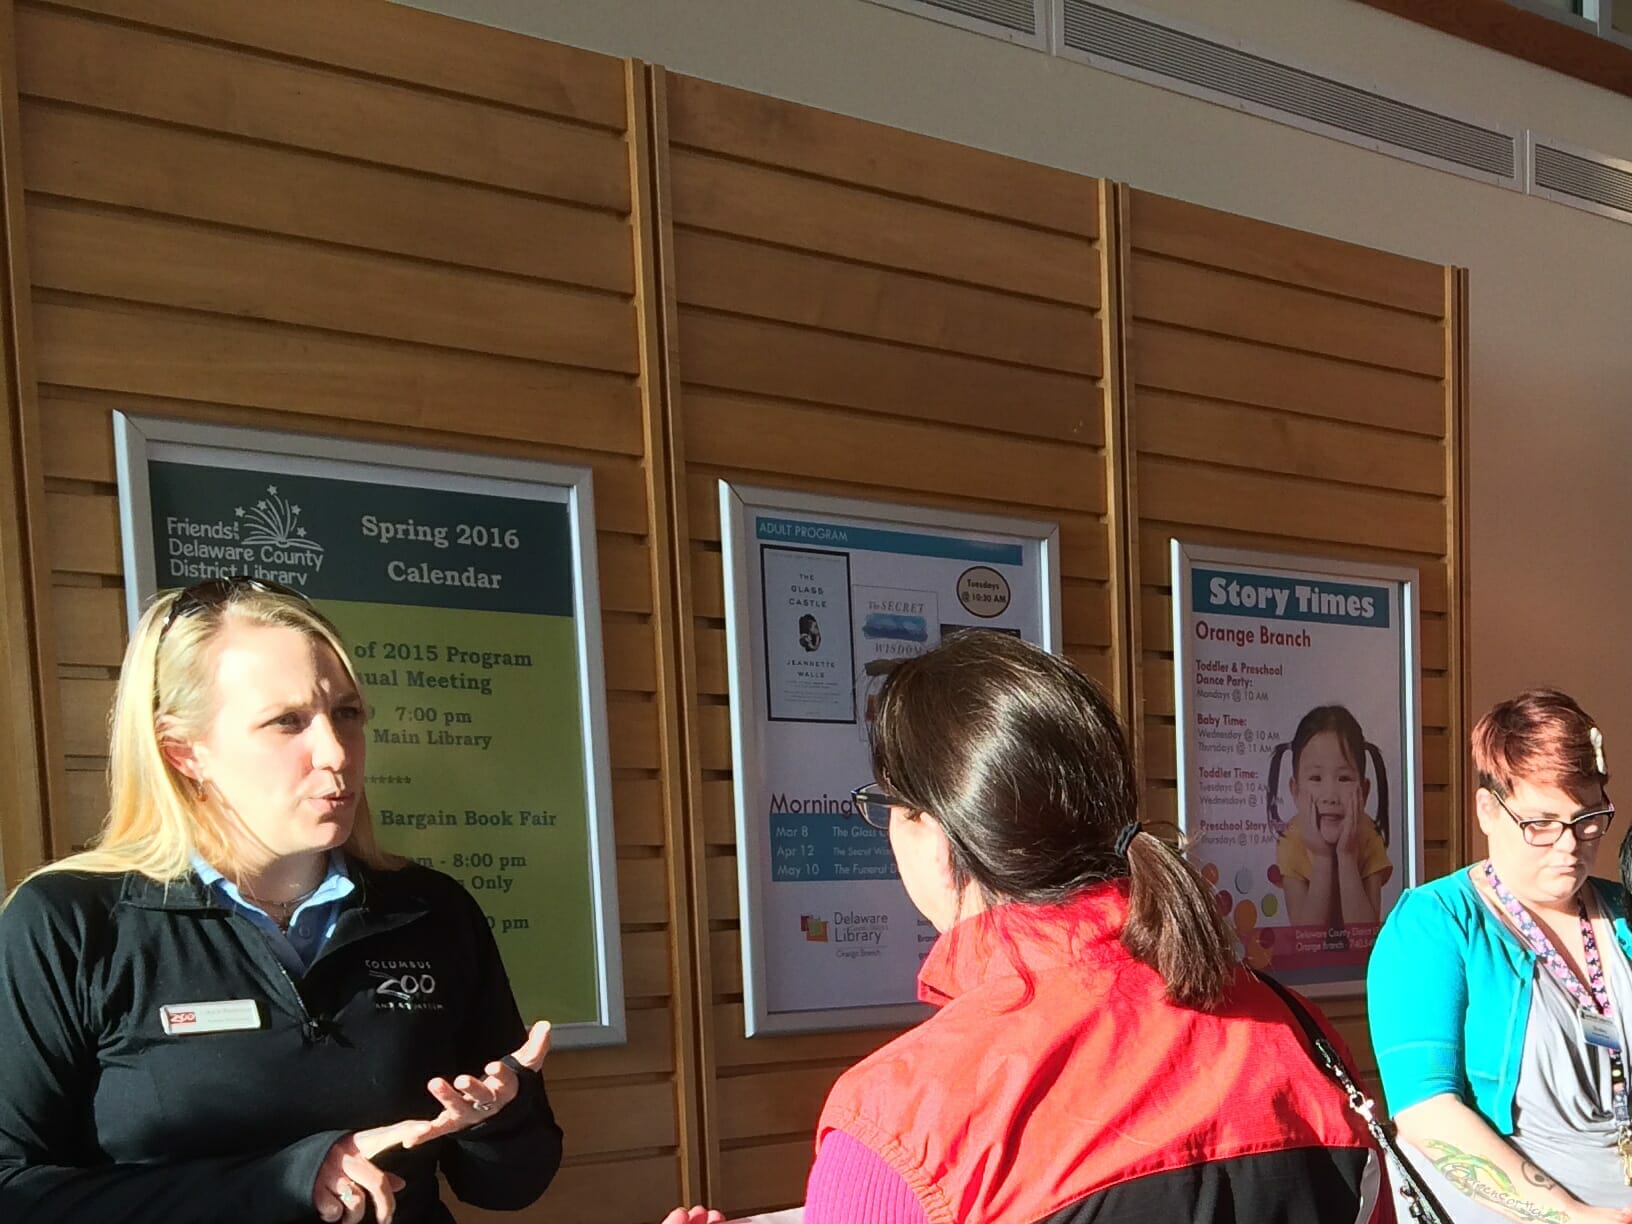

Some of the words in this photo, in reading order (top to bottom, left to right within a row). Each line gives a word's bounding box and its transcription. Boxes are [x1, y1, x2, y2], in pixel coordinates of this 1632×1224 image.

[167, 516, 232, 539] Friends
[361, 515, 449, 548] Spring
[456, 524, 520, 549] 2016
[759, 522, 792, 537] ADULT
[795, 526, 849, 542] PROGRAM
[168, 537, 255, 561] Delaware
[260, 545, 325, 572] County
[170, 558, 238, 580] District
[243, 564, 308, 586] Library
[387, 560, 503, 589] Calendar
[791, 585, 825, 595] GLASS
[966, 579, 1000, 591] Tuesdays
[788, 598, 828, 608] CASTLE
[1209, 576, 1291, 616] Story
[1295, 585, 1376, 619] Times
[880, 600, 925, 614] SECRET
[1195, 620, 1255, 647] Orange
[1260, 625, 1312, 648] Branch
[354, 641, 377, 659] of
[383, 643, 439, 662] 2015
[446, 646, 533, 669] Program
[1195, 659, 1229, 674] Toddler
[1231, 663, 1238, 673] &
[1240, 662, 1283, 677] Preschool
[406, 670, 493, 695] Meeting
[1196, 673, 1224, 686] Dance
[1227, 676, 1253, 688] Party:
[1197, 689, 1230, 701] Mondays
[1231, 689, 1241, 703] @
[1244, 690, 1254, 701] 10
[1255, 691, 1269, 701] AM
[395, 707, 438, 723] 7:00
[444, 711, 472, 726] pm
[1197, 713, 1220, 727] Baby
[1222, 714, 1247, 726] Time:
[373, 729, 420, 745] Main
[427, 730, 493, 750] Library
[1243, 728, 1254, 742] @
[1255, 730, 1266, 740] 10
[1267, 731, 1280, 740] AM
[1236, 741, 1246, 755] @
[1259, 744, 1272, 753] AM
[1198, 766, 1232, 778] Toddler
[1233, 767, 1259, 779] Time:
[1245, 782, 1256, 792] 10
[380, 810, 457, 830] Bargain
[464, 810, 513, 826] Book
[519, 810, 557, 826] Fair
[1200, 819, 1243, 831] Preschool
[1245, 819, 1267, 833] Story
[775, 826, 798, 838] Mar
[801, 825, 809, 837] 8
[832, 826, 848, 838] The
[776, 845, 797, 859] Apr
[800, 844, 815, 857] 12
[453, 853, 493, 867] 8:00
[499, 855, 527, 871] pm
[777, 864, 801, 879] May
[806, 863, 820, 876] 10
[834, 863, 851, 875] The
[472, 876, 513, 893] Only
[502, 917, 530, 933] pm
[833, 911, 889, 926] Delaware
[834, 927, 882, 945] Library
[365, 959, 432, 969] COLUMBUS
